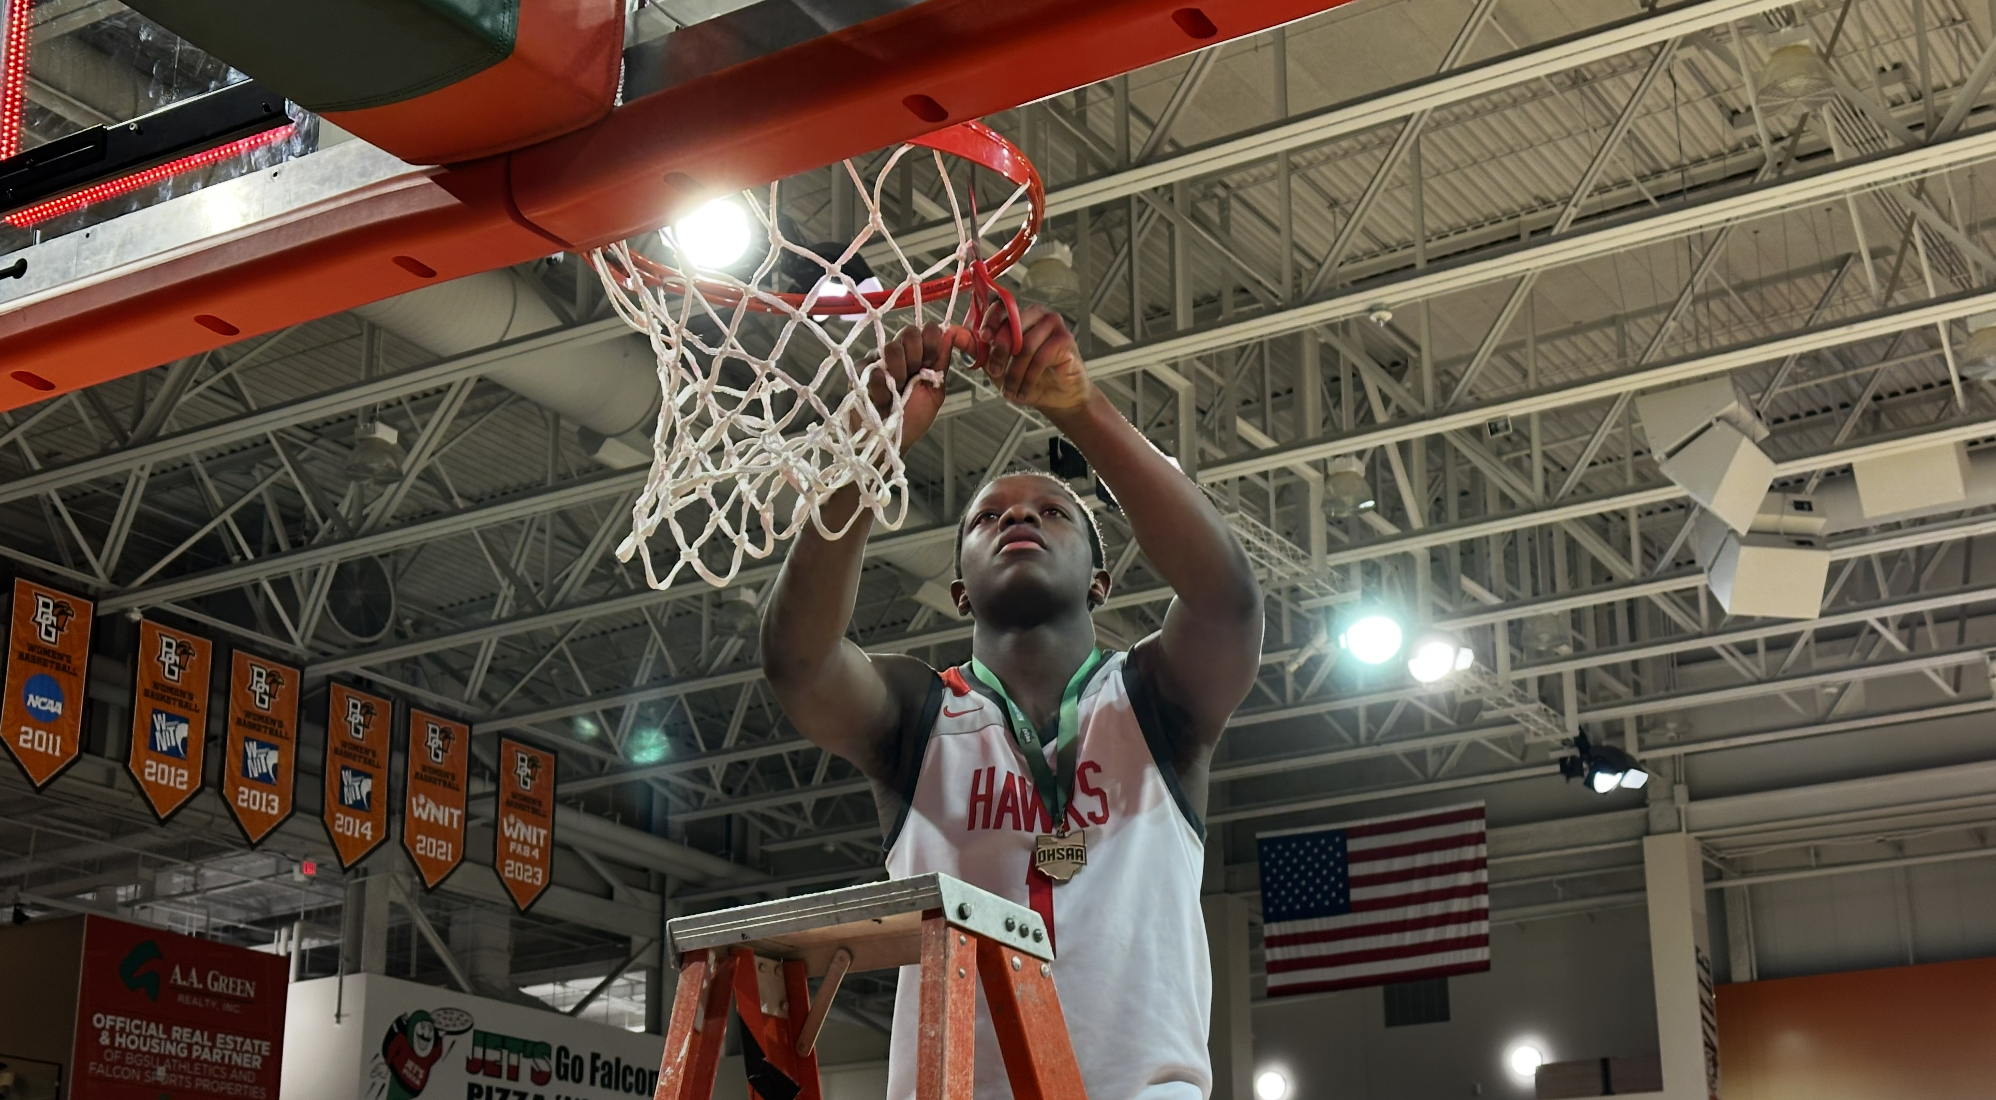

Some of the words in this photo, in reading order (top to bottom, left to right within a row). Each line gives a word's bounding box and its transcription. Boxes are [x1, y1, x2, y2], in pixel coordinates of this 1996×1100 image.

[18, 651, 78, 677] BASKETBALL
[27, 643, 72, 664] WOMEN'S
[27, 693, 63, 716] NCAA
[144, 689, 200, 713] BASKETBALL
[152, 681, 194, 701] WOMEN'S
[236, 717, 290, 740] BASKETBALL
[244, 710, 284, 728] WOMEN'S
[19, 726, 62, 758] 2011
[144, 760, 189, 791] 2012
[237, 786, 280, 815] 2013
[411, 793, 462, 830] WNIT
[334, 813, 372, 841] 2014
[503, 814, 548, 848] WNIT
[416, 834, 453, 862] 2021
[1037, 847, 1084, 864] OHSAA
[504, 859, 543, 887] 2023
[169, 963, 203, 988] A.A.
[207, 969, 256, 998] GREEN
[92, 1012, 167, 1039] OFFICIAL
[171, 1025, 212, 1047] REAL
[215, 1033, 271, 1056] ESTATE
[98, 1030, 111, 1046] &
[114, 1031, 188, 1058] HOUSING
[191, 1045, 263, 1070] PARTNER
[103, 1049, 122, 1062] OF
[164, 1059, 228, 1080] ATHLETICS
[230, 1068, 256, 1084] AND
[556, 1046, 584, 1084] Go
[88, 1061, 141, 1081] FALCON
[194, 1079, 267, 1100] PROPERTIES
